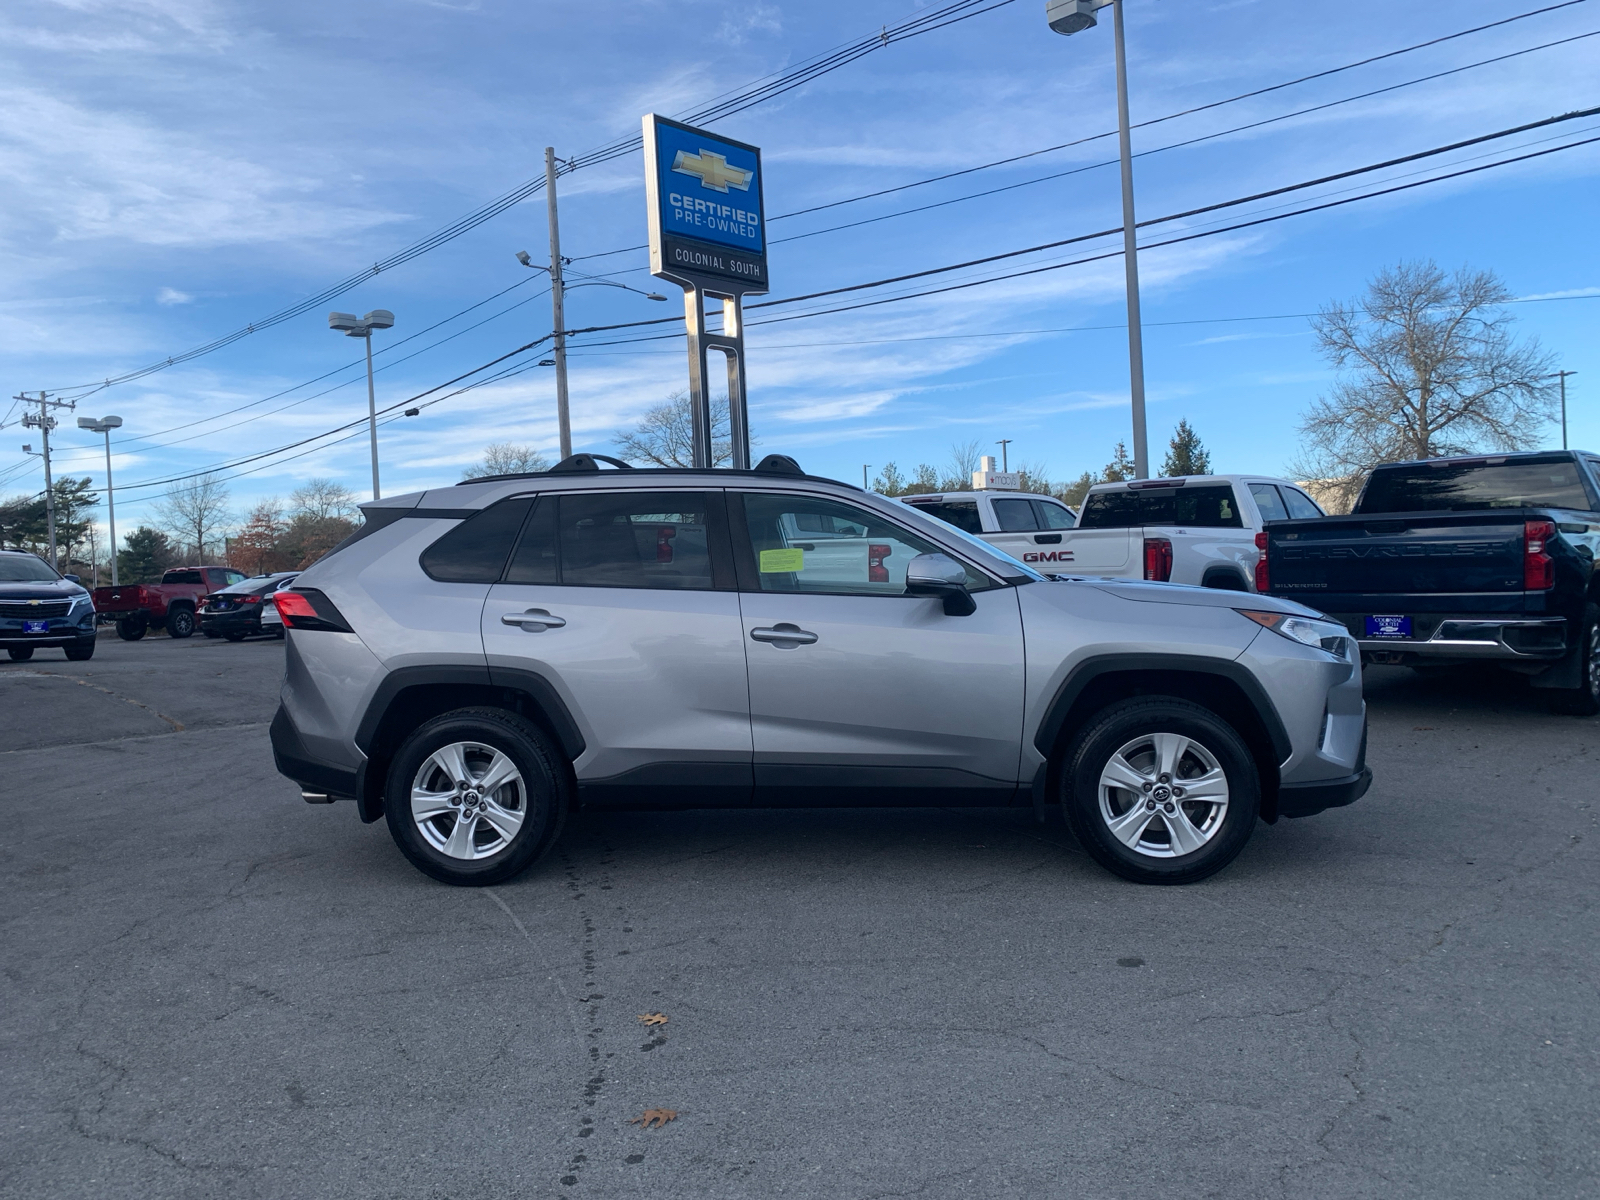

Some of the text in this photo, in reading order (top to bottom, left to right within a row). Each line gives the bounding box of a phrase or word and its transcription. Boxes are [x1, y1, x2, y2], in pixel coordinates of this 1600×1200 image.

[669, 192, 759, 226] CERTIFIED
[674, 208, 756, 238] PRE-OWNED
[675, 248, 760, 276] COLONIAL SOUTH
[1023, 551, 1075, 562] GMC
